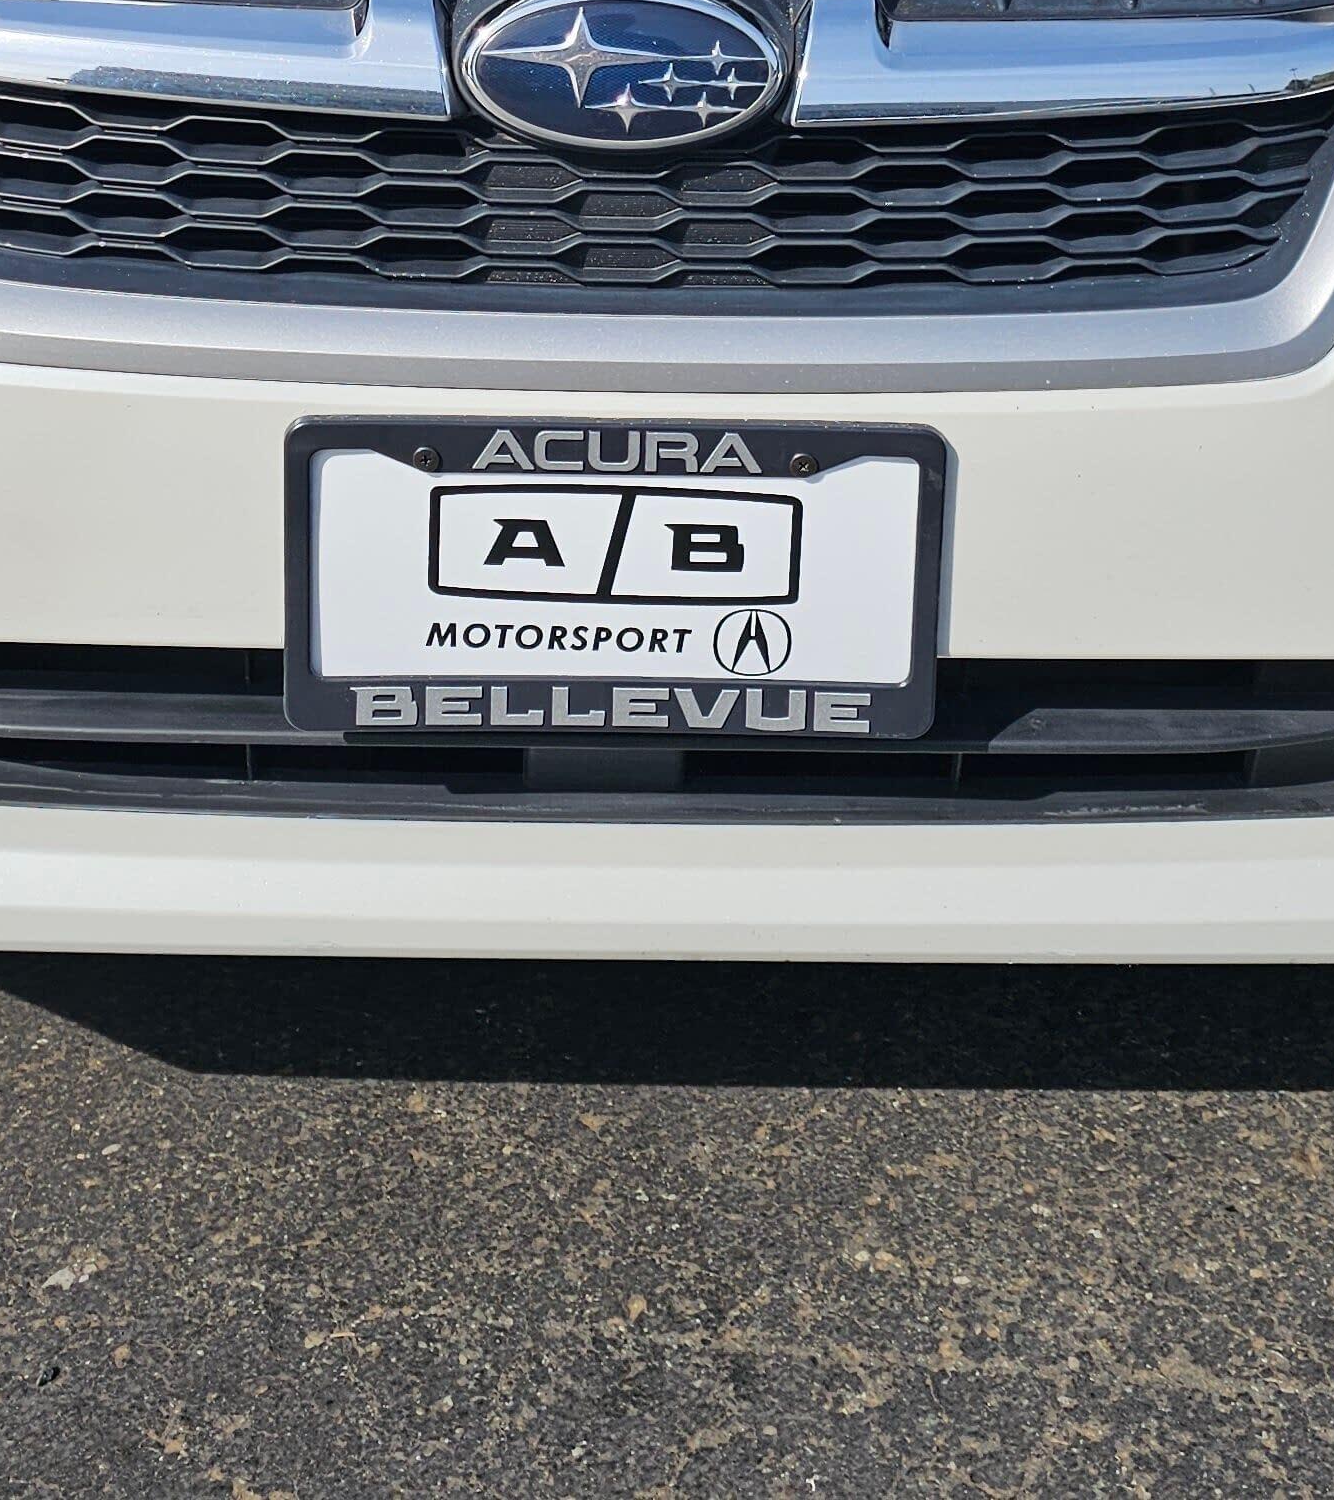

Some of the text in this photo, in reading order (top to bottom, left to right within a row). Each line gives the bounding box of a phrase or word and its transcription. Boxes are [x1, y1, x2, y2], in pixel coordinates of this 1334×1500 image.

[471, 430, 763, 475] ACURA
[483, 518, 745, 573] A B
[425, 622, 693, 655] MOTORSPORT
[349, 685, 872, 734] BELLEVUE
